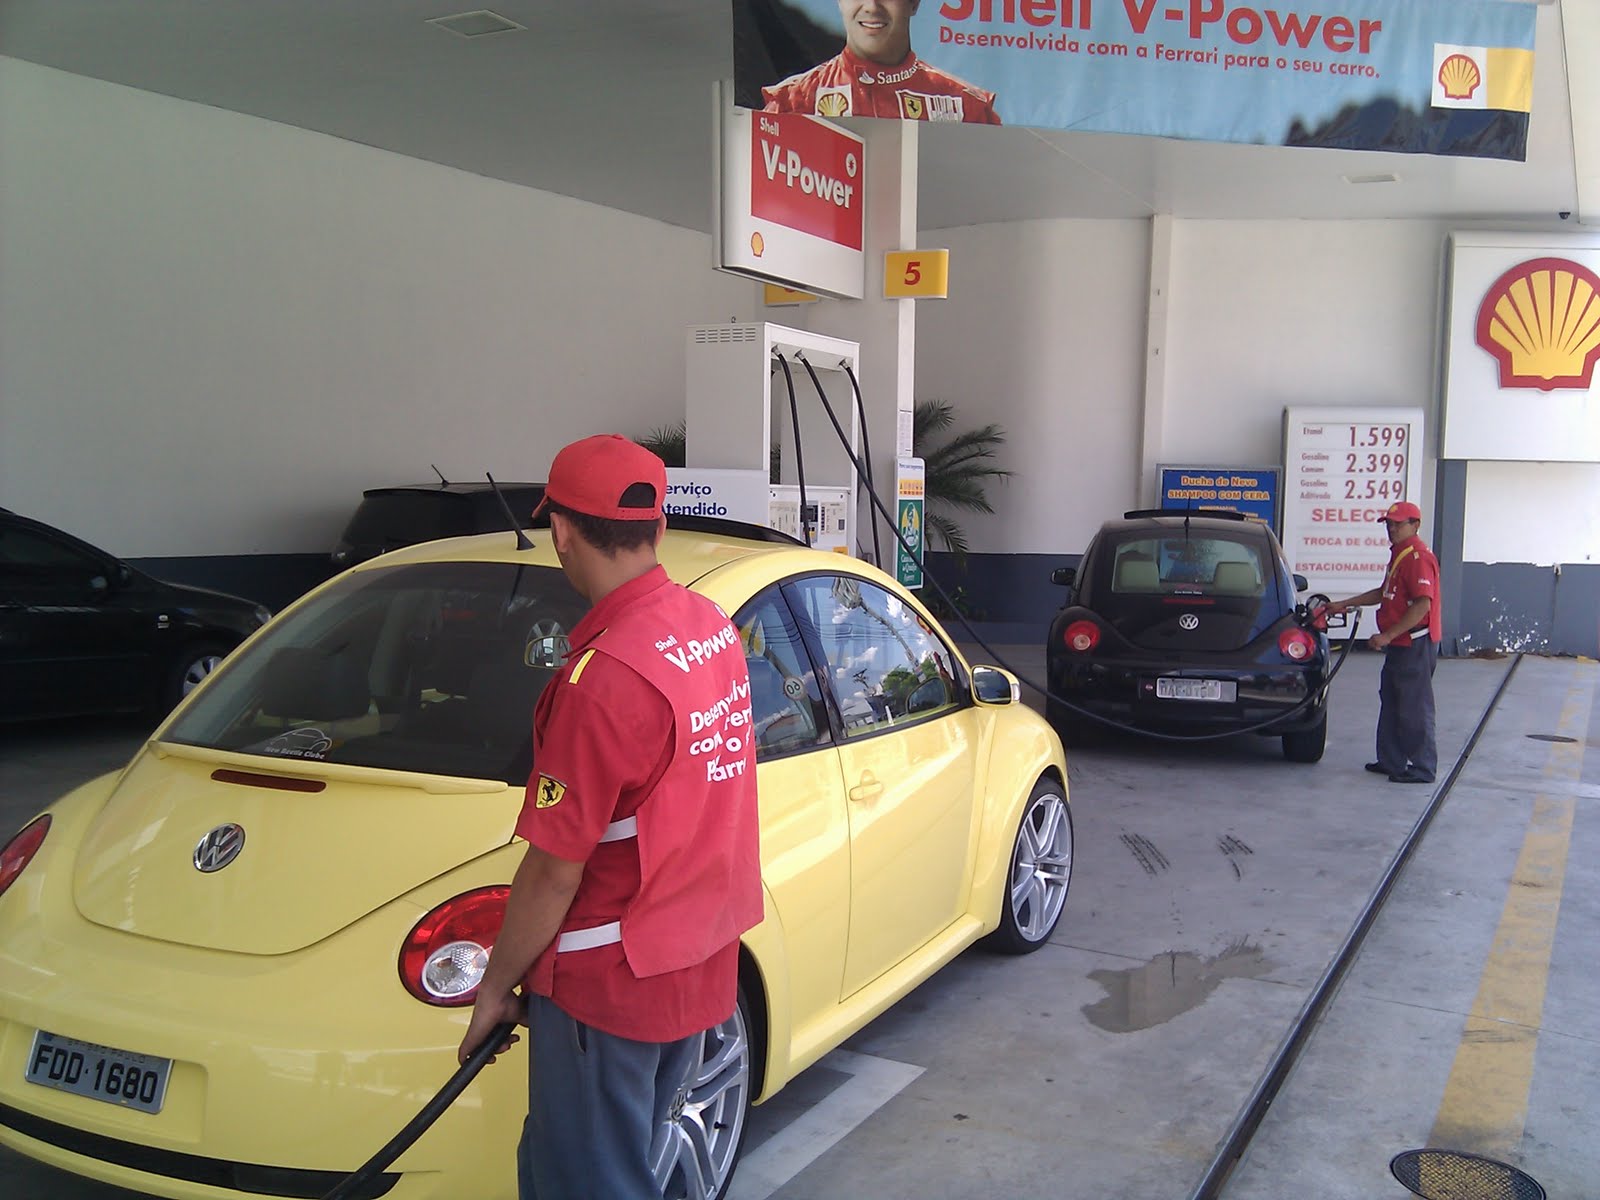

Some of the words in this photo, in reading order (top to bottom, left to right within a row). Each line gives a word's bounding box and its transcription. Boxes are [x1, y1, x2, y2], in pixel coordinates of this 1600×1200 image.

[1123, 0, 1382, 54] V-Power
[939, 26, 1080, 53] Desenvolvida
[1087, 42, 1128, 56] com
[1136, 46, 1148, 58] a
[1155, 44, 1218, 64] Ferrari
[1224, 54, 1270, 70] para
[1276, 56, 1287, 69] o
[1293, 58, 1323, 73] seu
[1330, 62, 1380, 78] carro.
[760, 117, 780, 136] Shell
[761, 139, 853, 209] V-Power
[904, 261, 921, 286] 5
[1350, 426, 1406, 447] 1.599
[1346, 453, 1405, 473] 2.399
[666, 481, 712, 498] erviço
[1181, 475, 1214, 486] Ducha
[1215, 476, 1229, 486] de
[1231, 477, 1258, 487] Neve
[1344, 480, 1403, 500] 2.549
[1168, 489, 1216, 499] SHAMPOO
[1218, 490, 1240, 500] COM
[1242, 491, 1270, 500] CERA
[1303, 537, 1342, 546] TROCA
[1346, 537, 1360, 546] DE
[1295, 562, 1386, 572] ESTACIONAMEN
[655, 634, 678, 653] Shell
[664, 623, 739, 673] V-Power
